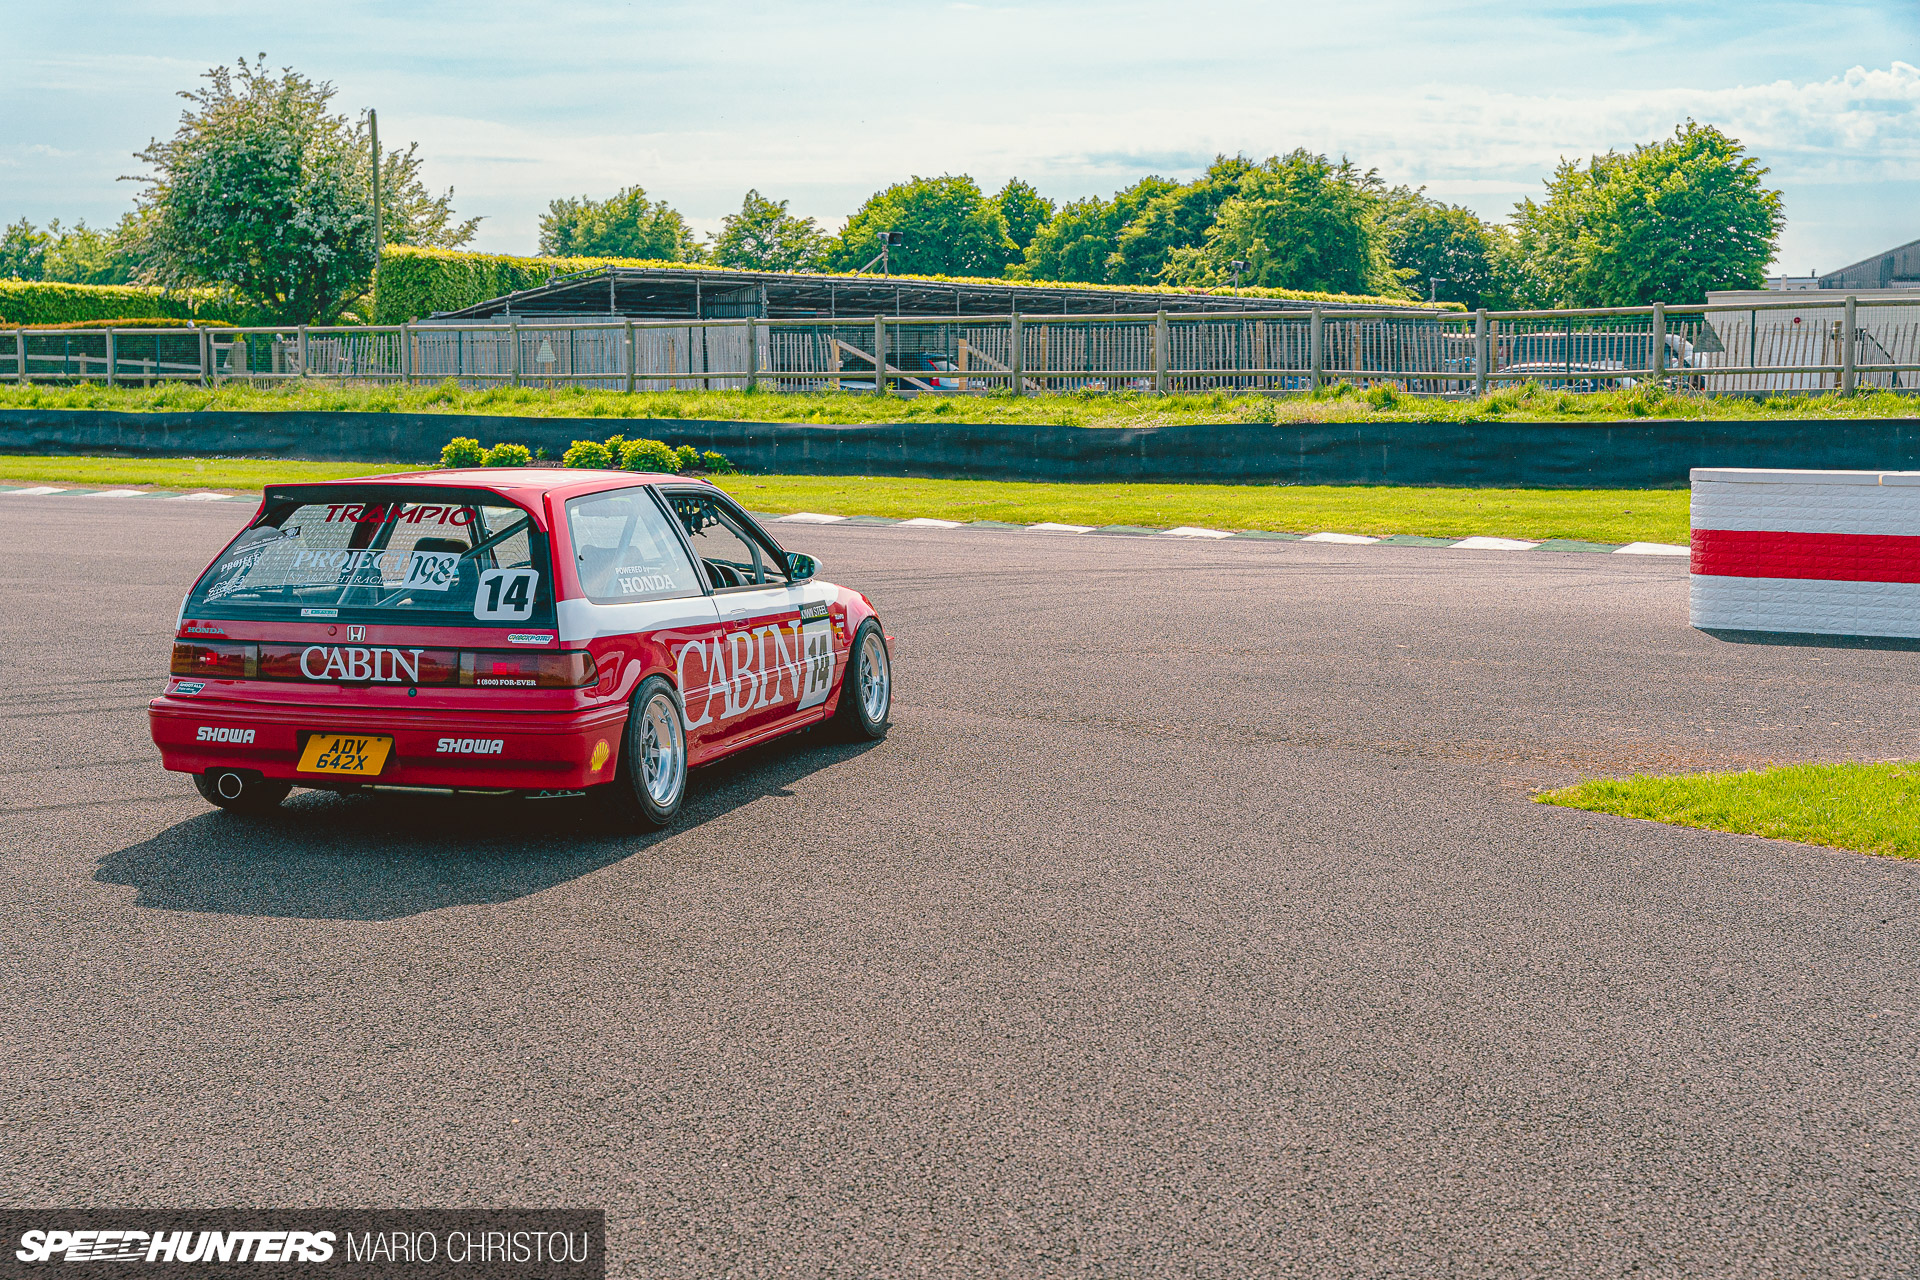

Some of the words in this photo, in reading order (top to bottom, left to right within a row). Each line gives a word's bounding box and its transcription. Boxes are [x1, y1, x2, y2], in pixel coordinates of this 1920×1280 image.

[325, 504, 477, 527] TRAMPIO
[293, 551, 410, 573] PROJECT
[407, 555, 455, 586] 198
[615, 565, 643, 575] POWERED
[289, 573, 352, 584] STARLIGHT
[618, 574, 677, 594] HONDA
[484, 575, 531, 612] 14
[812, 604, 829, 617] STEEL
[187, 626, 225, 635] HONDA
[300, 645, 425, 683] CABIN
[481, 678, 499, 686] (800)
[677, 619, 802, 731] CABIN
[808, 634, 829, 693] 14
[196, 726, 256, 744] SHOWA
[328, 738, 369, 755] ADV
[436, 738, 504, 754] SHOWA
[315, 753, 368, 770] 642X
